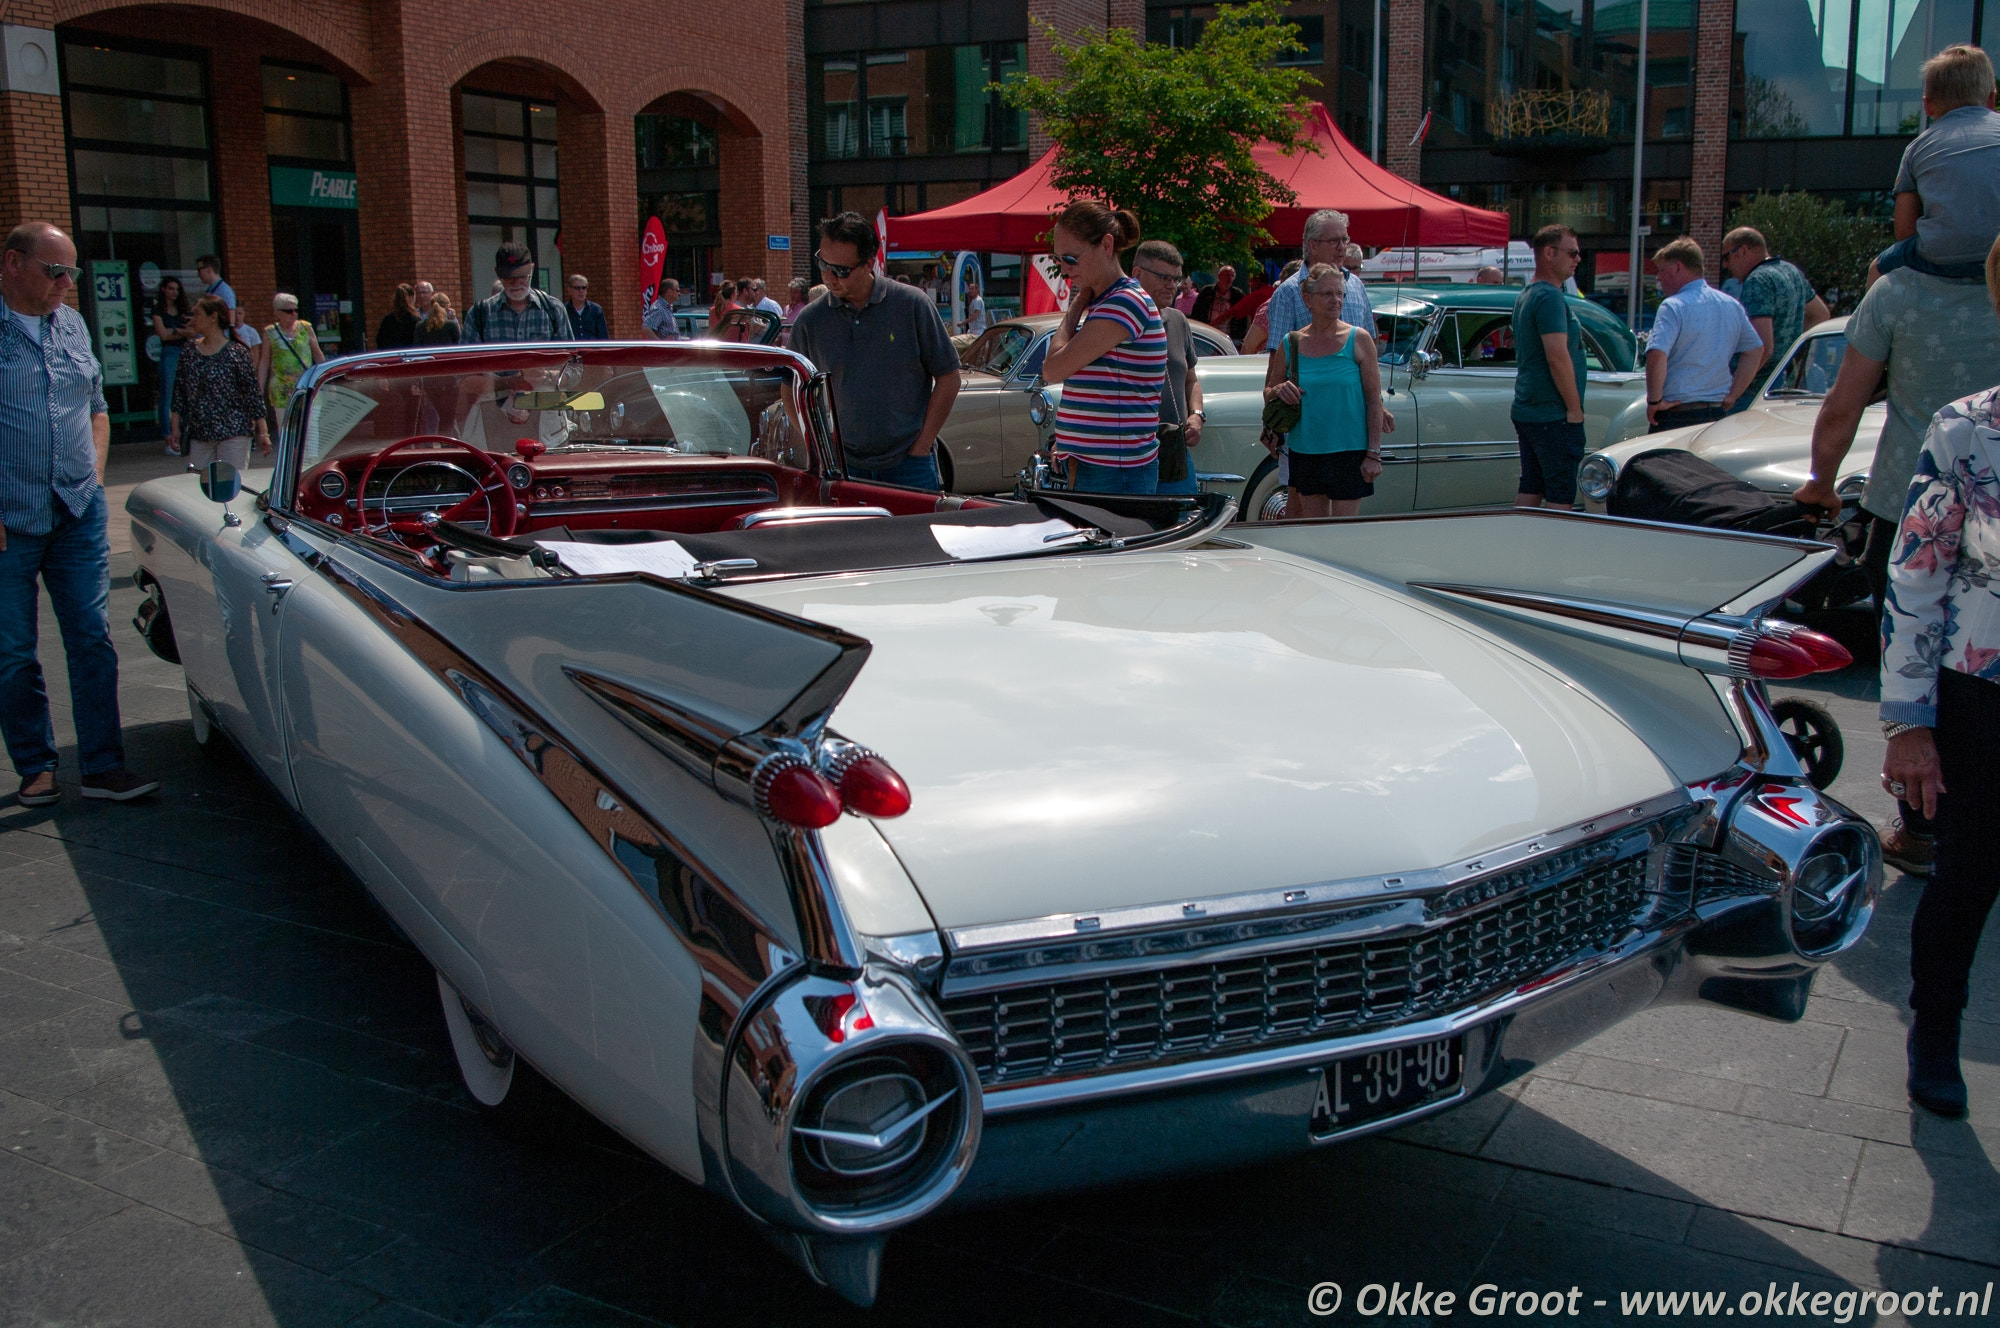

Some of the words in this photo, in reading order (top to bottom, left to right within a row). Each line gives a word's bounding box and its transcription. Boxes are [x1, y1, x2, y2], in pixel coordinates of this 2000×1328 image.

[1540, 202, 1607, 215] GEMEENTE
[96, 275, 111, 299] 3
[115, 275, 127, 298] 1
[1312, 1039, 1451, 1119] AL-39-98
